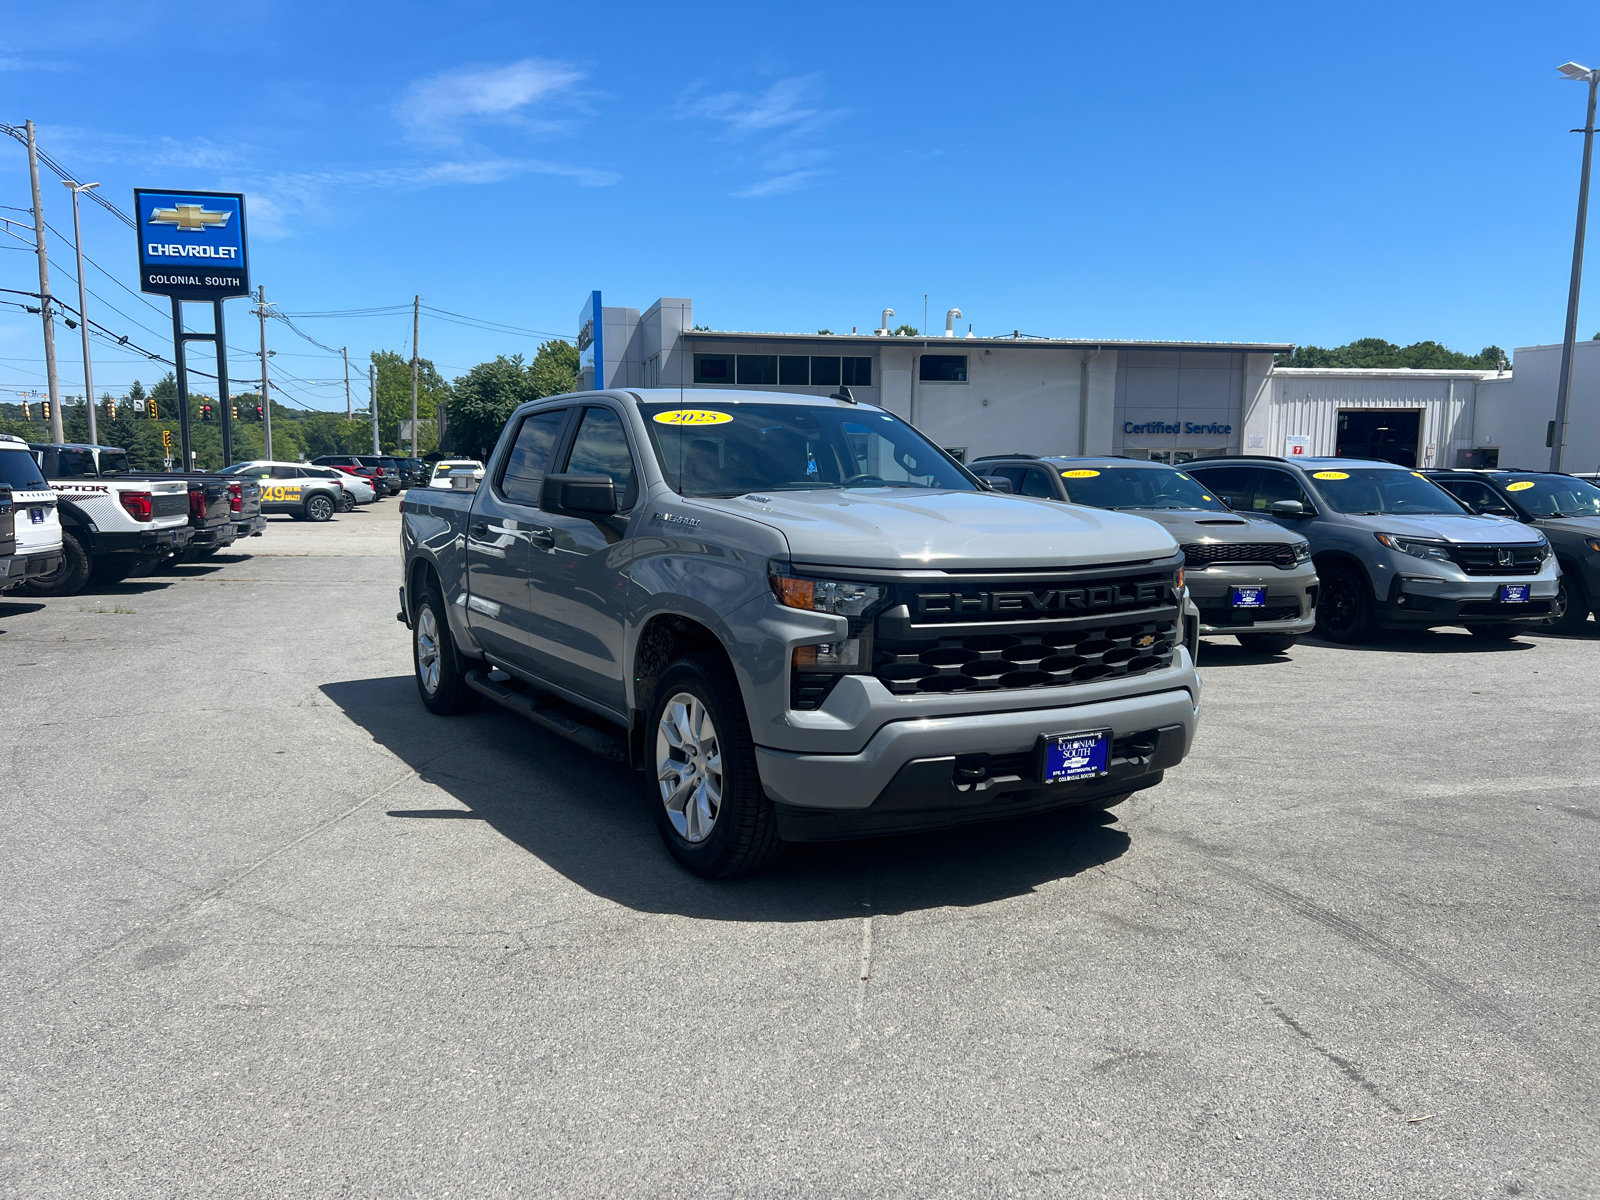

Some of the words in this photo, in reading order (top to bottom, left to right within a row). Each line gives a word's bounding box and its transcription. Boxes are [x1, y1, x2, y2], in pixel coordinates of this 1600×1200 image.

[148, 244, 237, 258] CHEVROLET
[149, 275, 201, 285] COLONIAL
[205, 277, 240, 287] SOUTH
[669, 413, 718, 422] 2025
[1124, 421, 1181, 435] Certified
[1185, 422, 1232, 435] Service
[50, 485, 111, 495] APTOR
[158, 501, 187, 510] FORD
[916, 581, 1173, 612] CHEVROLET
[1058, 739, 1097, 750] COLONIAL
[1063, 748, 1091, 759] SOUTH
